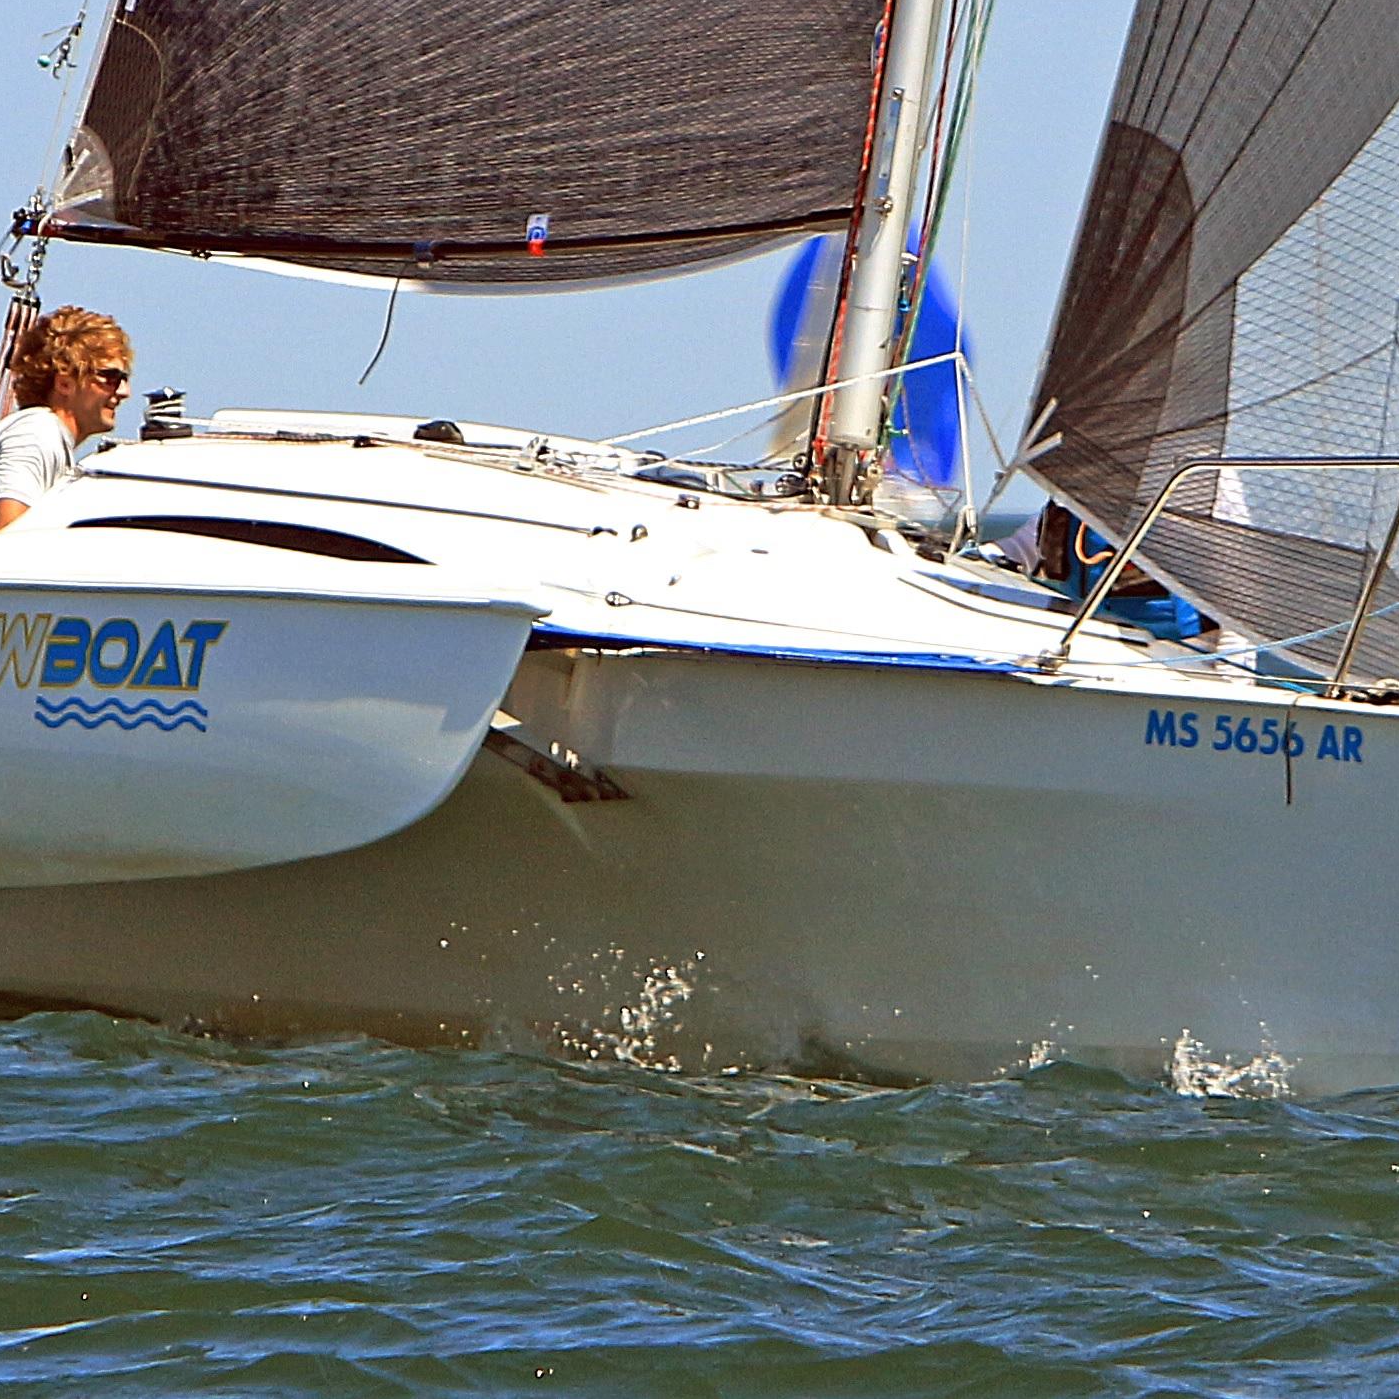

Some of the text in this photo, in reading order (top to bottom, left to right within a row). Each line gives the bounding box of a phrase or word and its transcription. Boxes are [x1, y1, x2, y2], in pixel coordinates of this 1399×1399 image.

[1145, 709, 1363, 762] MS 5656 AR
